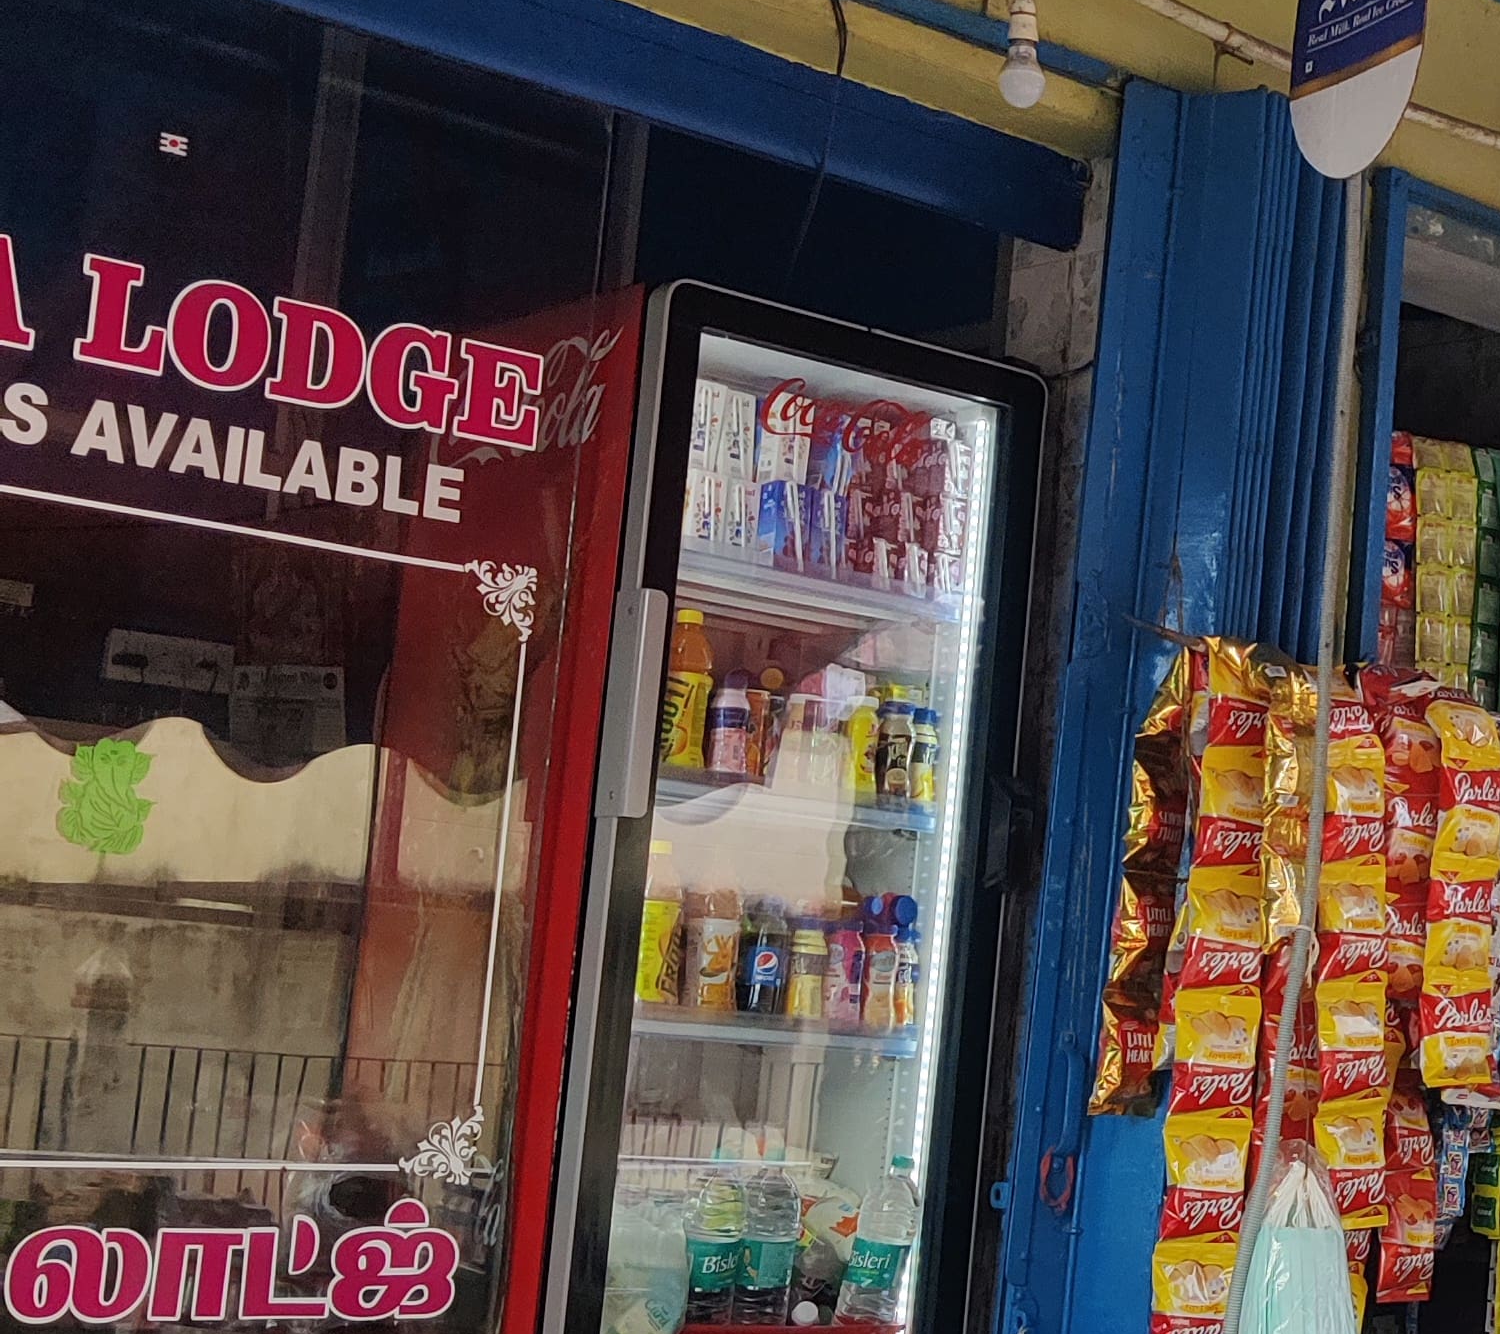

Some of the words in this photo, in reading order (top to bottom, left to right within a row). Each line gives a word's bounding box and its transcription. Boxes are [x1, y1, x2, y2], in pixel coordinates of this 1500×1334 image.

[1307, 29, 1328, 47] Real
[73, 252, 544, 452] LODGE
[70, 398, 465, 524] AVAILABLE
[4, 1198, 461, 1324] லாட்ஜ்
